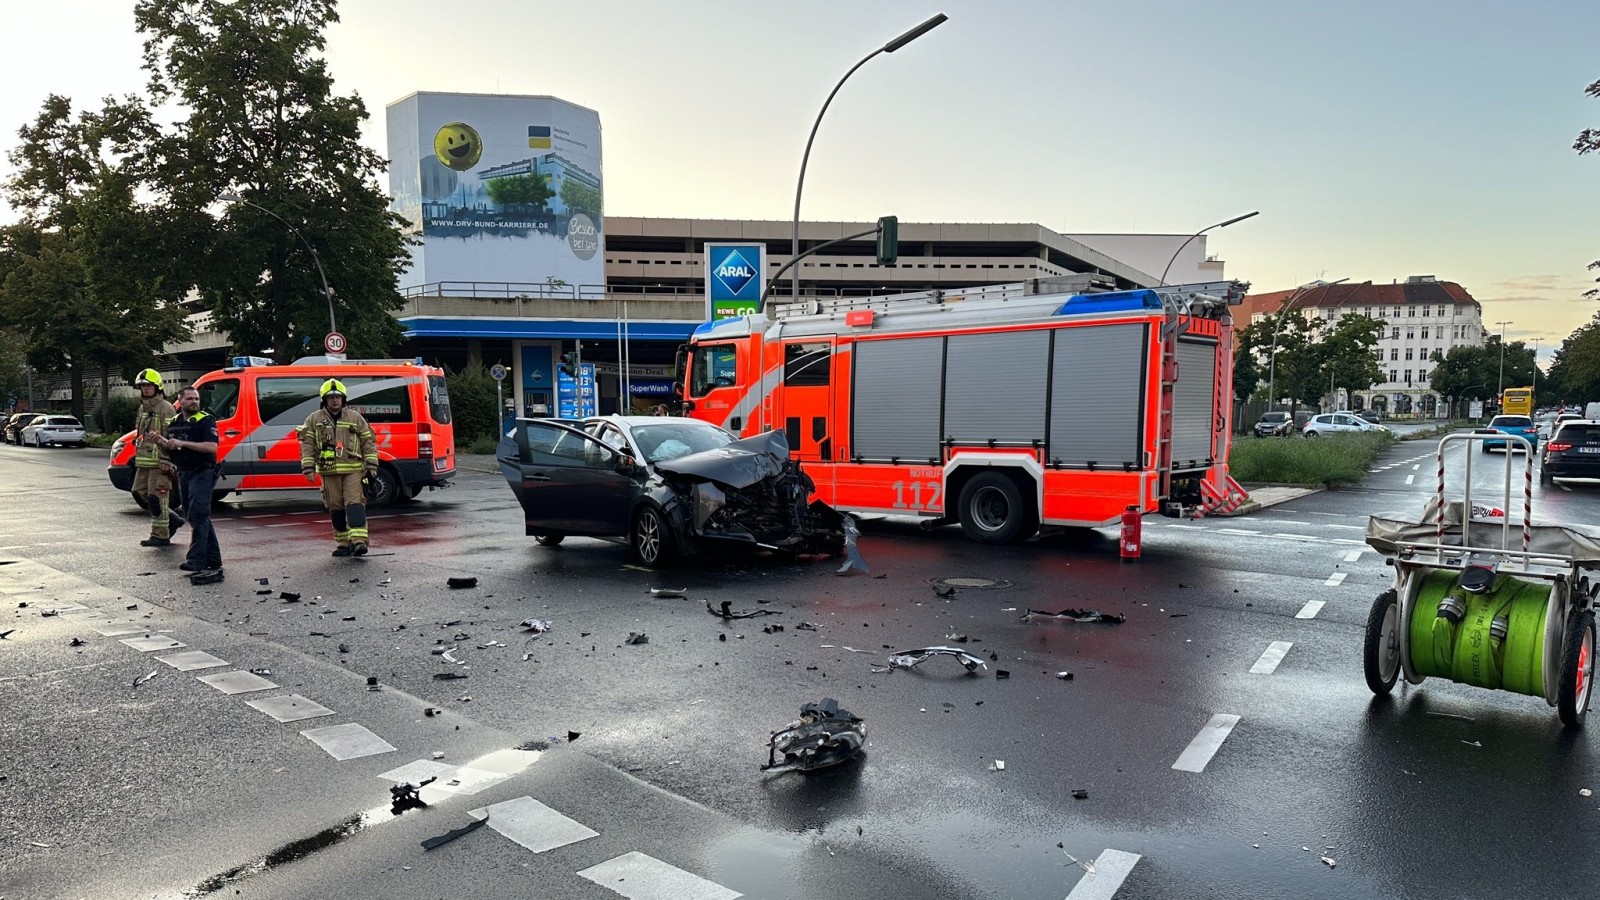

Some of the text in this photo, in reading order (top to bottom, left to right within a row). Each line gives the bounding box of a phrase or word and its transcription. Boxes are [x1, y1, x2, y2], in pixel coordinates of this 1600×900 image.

[431, 219, 549, 229] WWW.DRV-BUND-KARRIERE.DE
[569, 217, 595, 235] Besser
[573, 237, 584, 249] bei
[719, 266, 751, 277] ARAL
[737, 307, 756, 316] GO
[330, 338, 341, 348] 30
[630, 384, 668, 394] SuperWash
[910, 468, 941, 478] NOTRUF
[892, 480, 941, 510] 112
